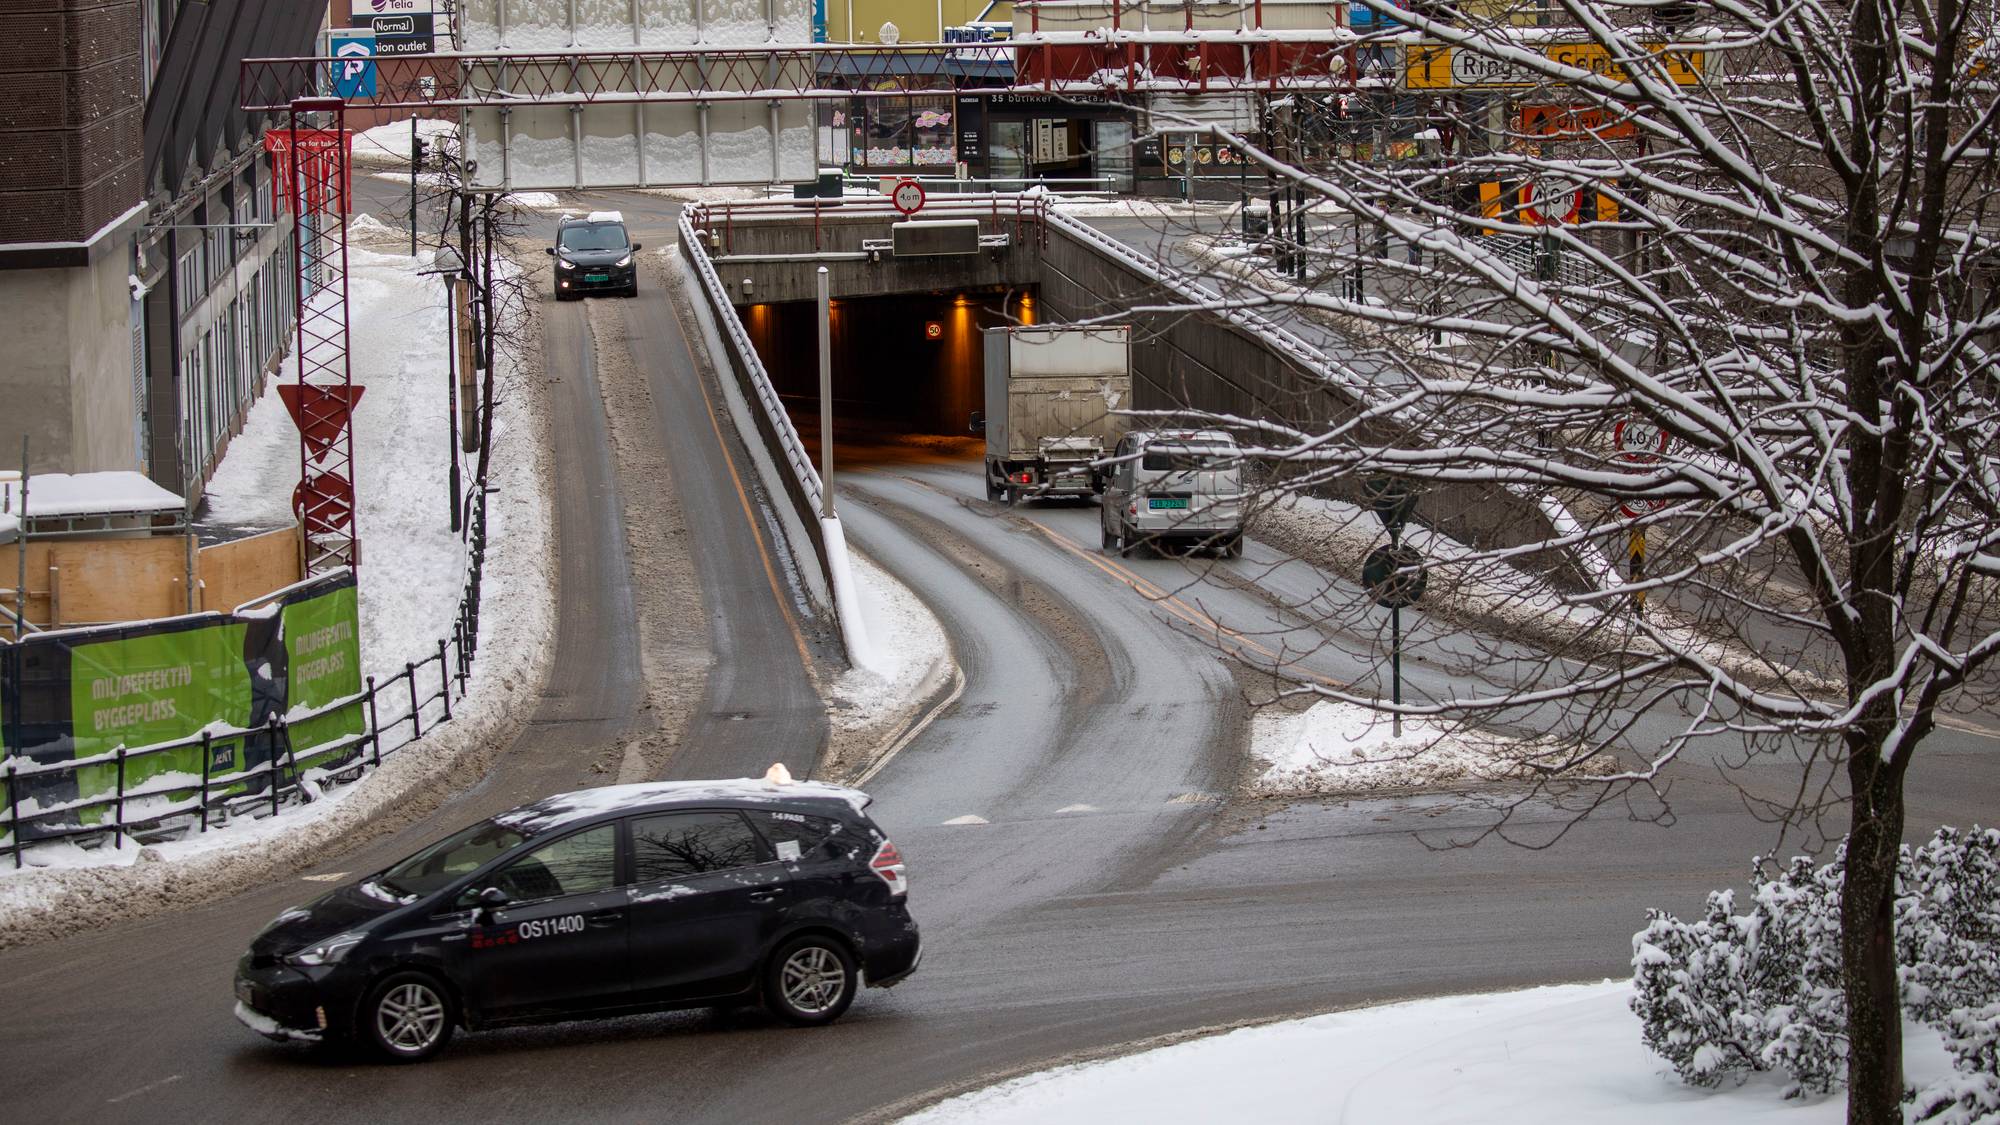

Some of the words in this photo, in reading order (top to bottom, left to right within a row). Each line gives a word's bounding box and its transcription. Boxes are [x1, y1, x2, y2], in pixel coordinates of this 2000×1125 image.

[390, 0, 413, 9] Telia
[376, 20, 409, 32] Normal
[397, 41, 427, 52] outlet
[1463, 55, 1513, 80] Ring
[929, 326, 940, 335] 50
[92, 664, 192, 701] MILJØEFFEKTIV
[93, 698, 177, 731] BYGGEPLASS
[518, 914, 585, 939] OS11400
